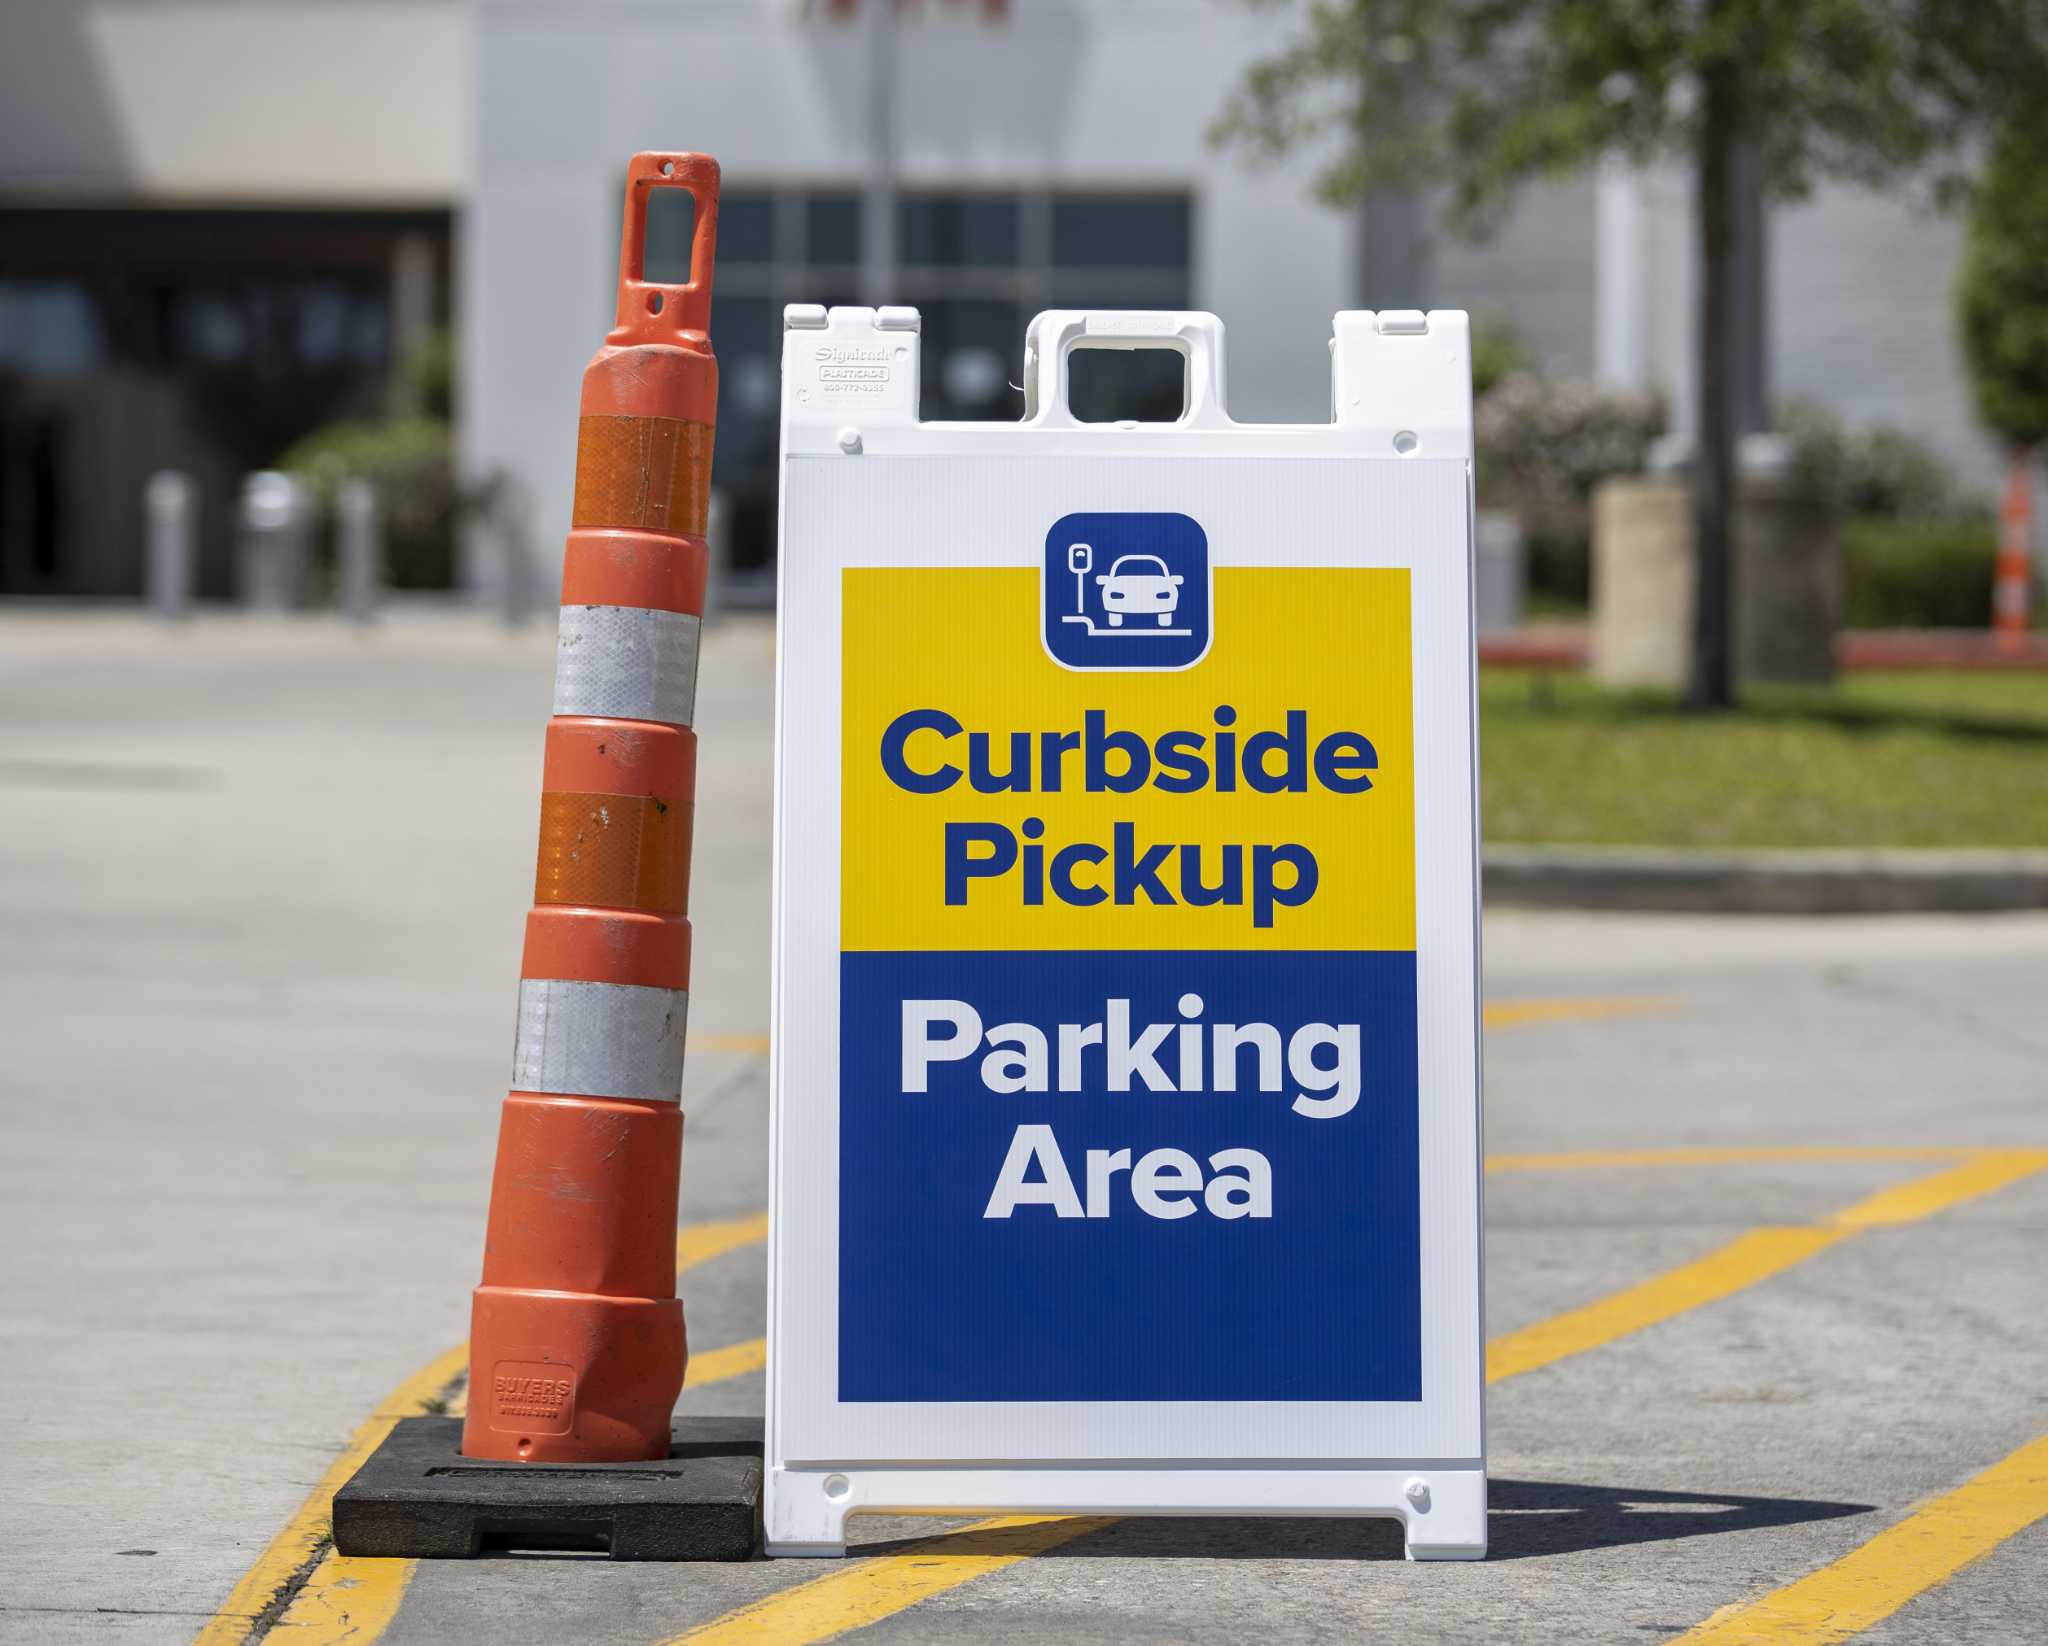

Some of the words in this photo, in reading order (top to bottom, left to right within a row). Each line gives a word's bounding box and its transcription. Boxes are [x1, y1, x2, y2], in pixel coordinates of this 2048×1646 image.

[881, 705, 1378, 794] Curbside
[945, 817, 1318, 928] Pickup
[902, 994, 1360, 1119] Parking
[984, 1125, 1272, 1220] Area
[495, 1376, 570, 1397] BUYERS
